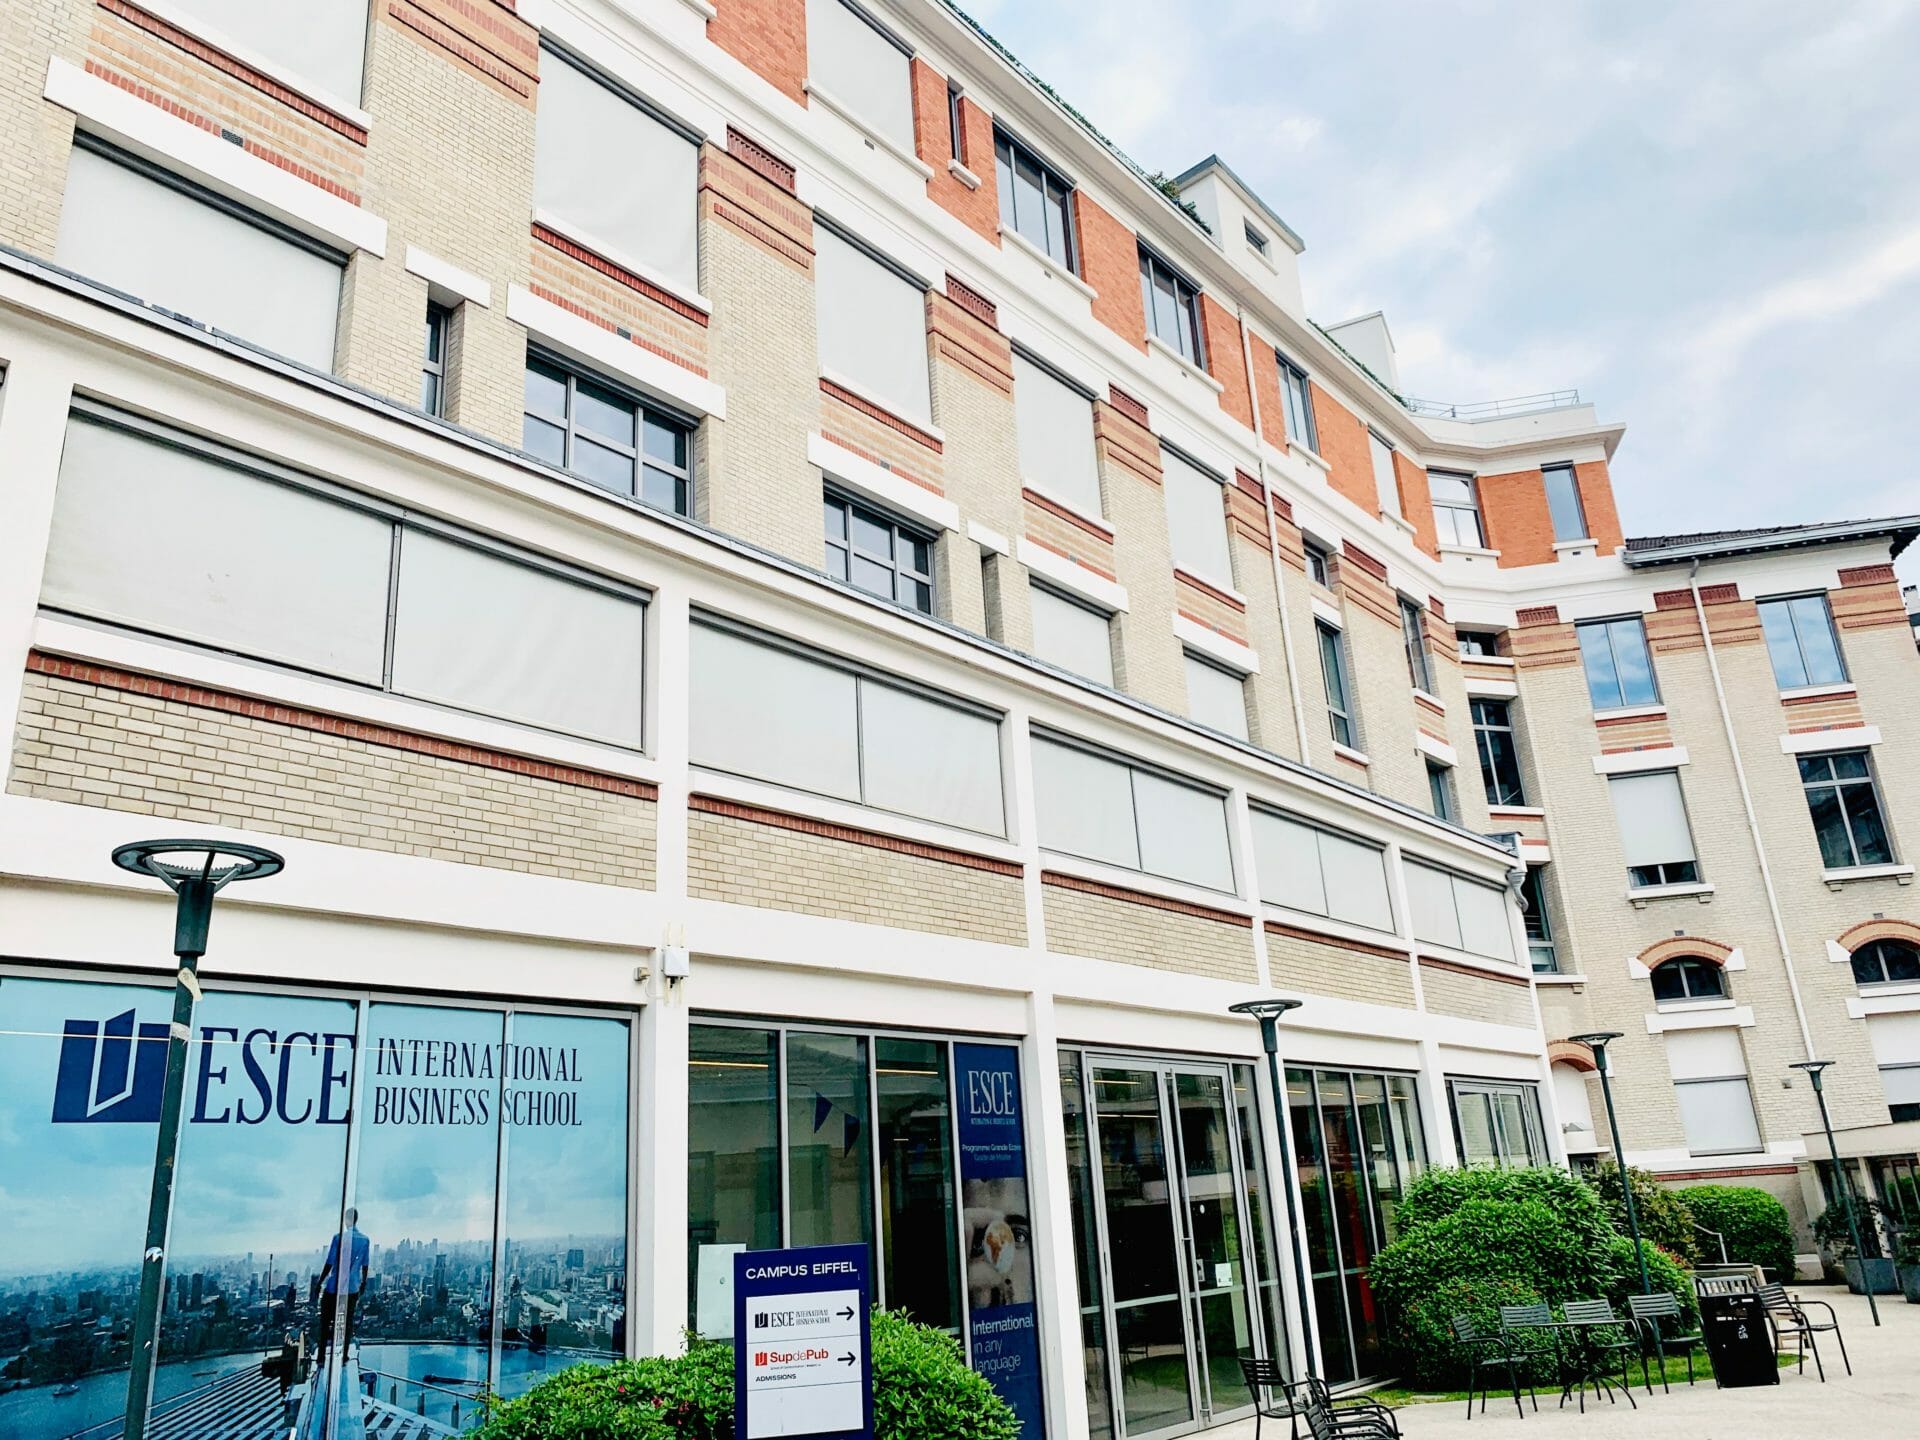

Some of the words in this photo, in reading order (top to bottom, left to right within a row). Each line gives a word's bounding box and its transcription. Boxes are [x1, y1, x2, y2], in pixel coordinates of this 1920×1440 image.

[376, 1037, 583, 1082] INTERNATIONAL
[190, 1026, 356, 1125] ESCE
[967, 1070, 1015, 1115] ESCE
[373, 1086, 490, 1126] BUSINESS
[502, 1087, 583, 1127] SCHOOL
[745, 1264, 808, 1280] CAMPUS
[812, 1261, 858, 1275] EIFFEL
[771, 1311, 795, 1328] ESCE
[972, 1312, 1034, 1336] International
[770, 1347, 829, 1364] SupdePub
[974, 1342, 983, 1354] in
[984, 1339, 1003, 1355] any
[975, 1354, 1021, 1375] language
[755, 1373, 797, 1383] ADMISSIONS
